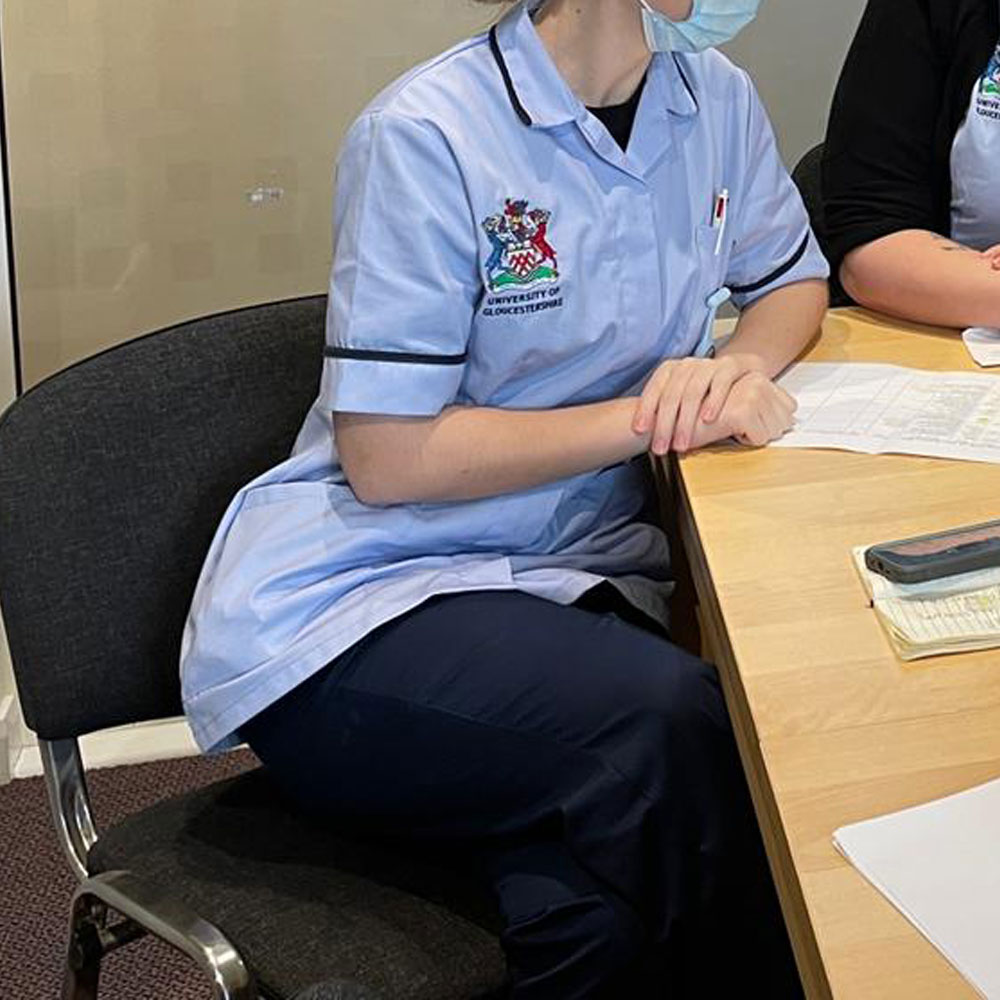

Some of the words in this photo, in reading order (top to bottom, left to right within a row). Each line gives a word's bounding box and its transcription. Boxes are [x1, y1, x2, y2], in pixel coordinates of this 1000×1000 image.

[487, 291, 548, 305] UNIVERSITY
[548, 287, 560, 297] OF
[482, 298, 564, 317] GLOUCESTERSHIRE
